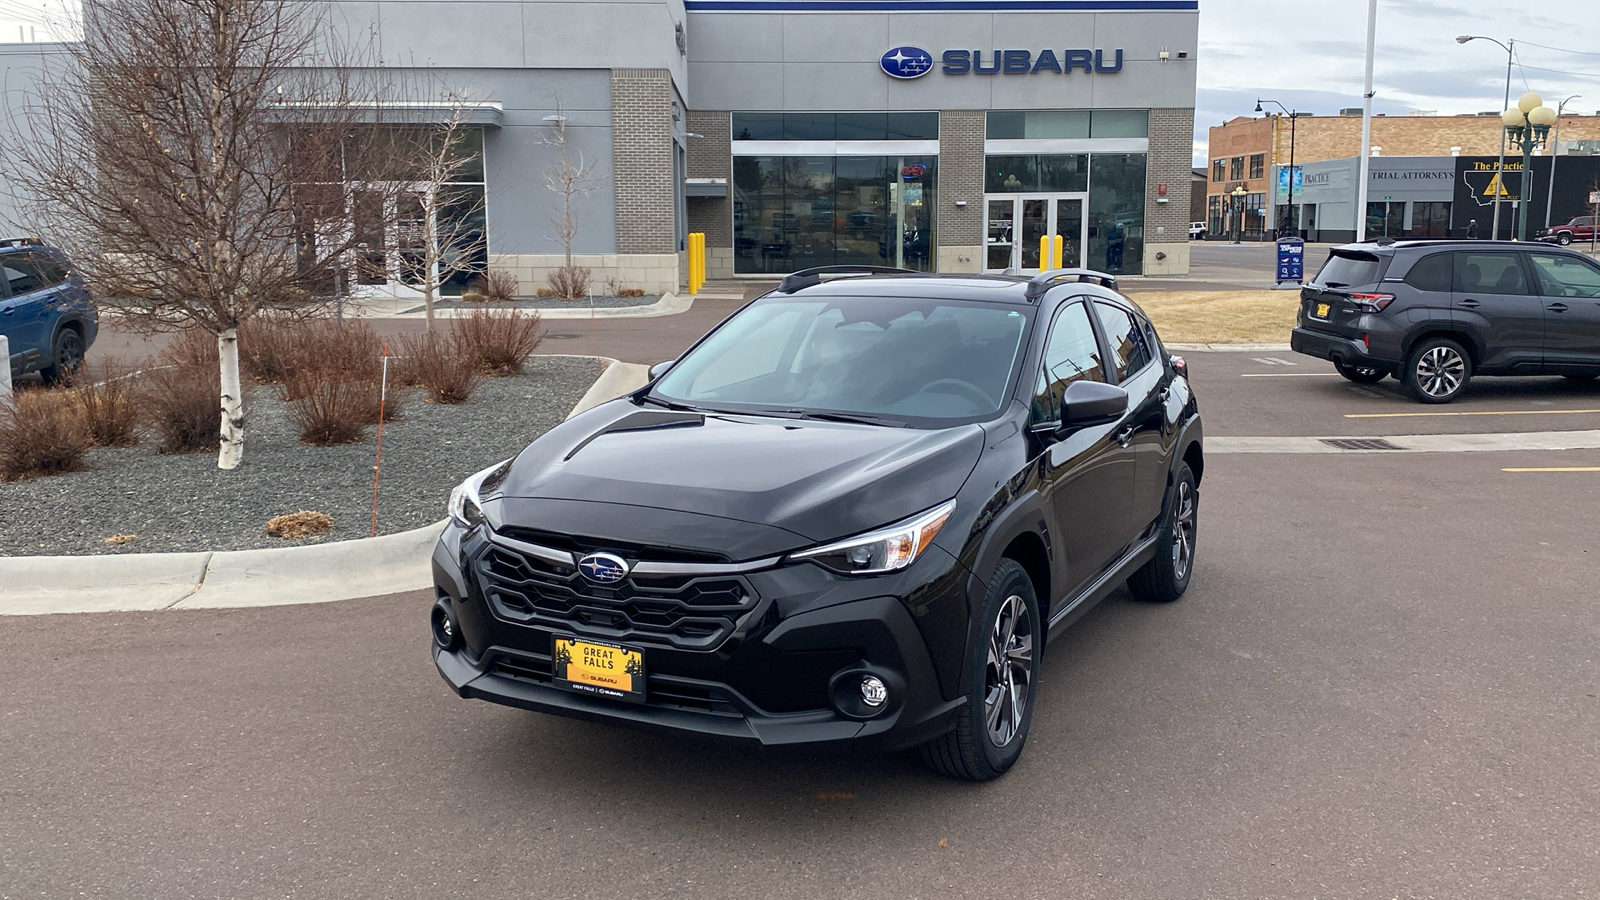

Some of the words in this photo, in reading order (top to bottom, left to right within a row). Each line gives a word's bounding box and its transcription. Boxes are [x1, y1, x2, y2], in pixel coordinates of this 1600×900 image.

[942, 48, 1123, 75] SUBARU
[1473, 162, 1491, 170] The
[1493, 162, 1524, 170] Pactic
[1304, 173, 1330, 183] PRACTICE
[583, 647, 613, 659] GREAT
[584, 657, 613, 669] FALLS
[590, 675, 617, 684] SUBARU
